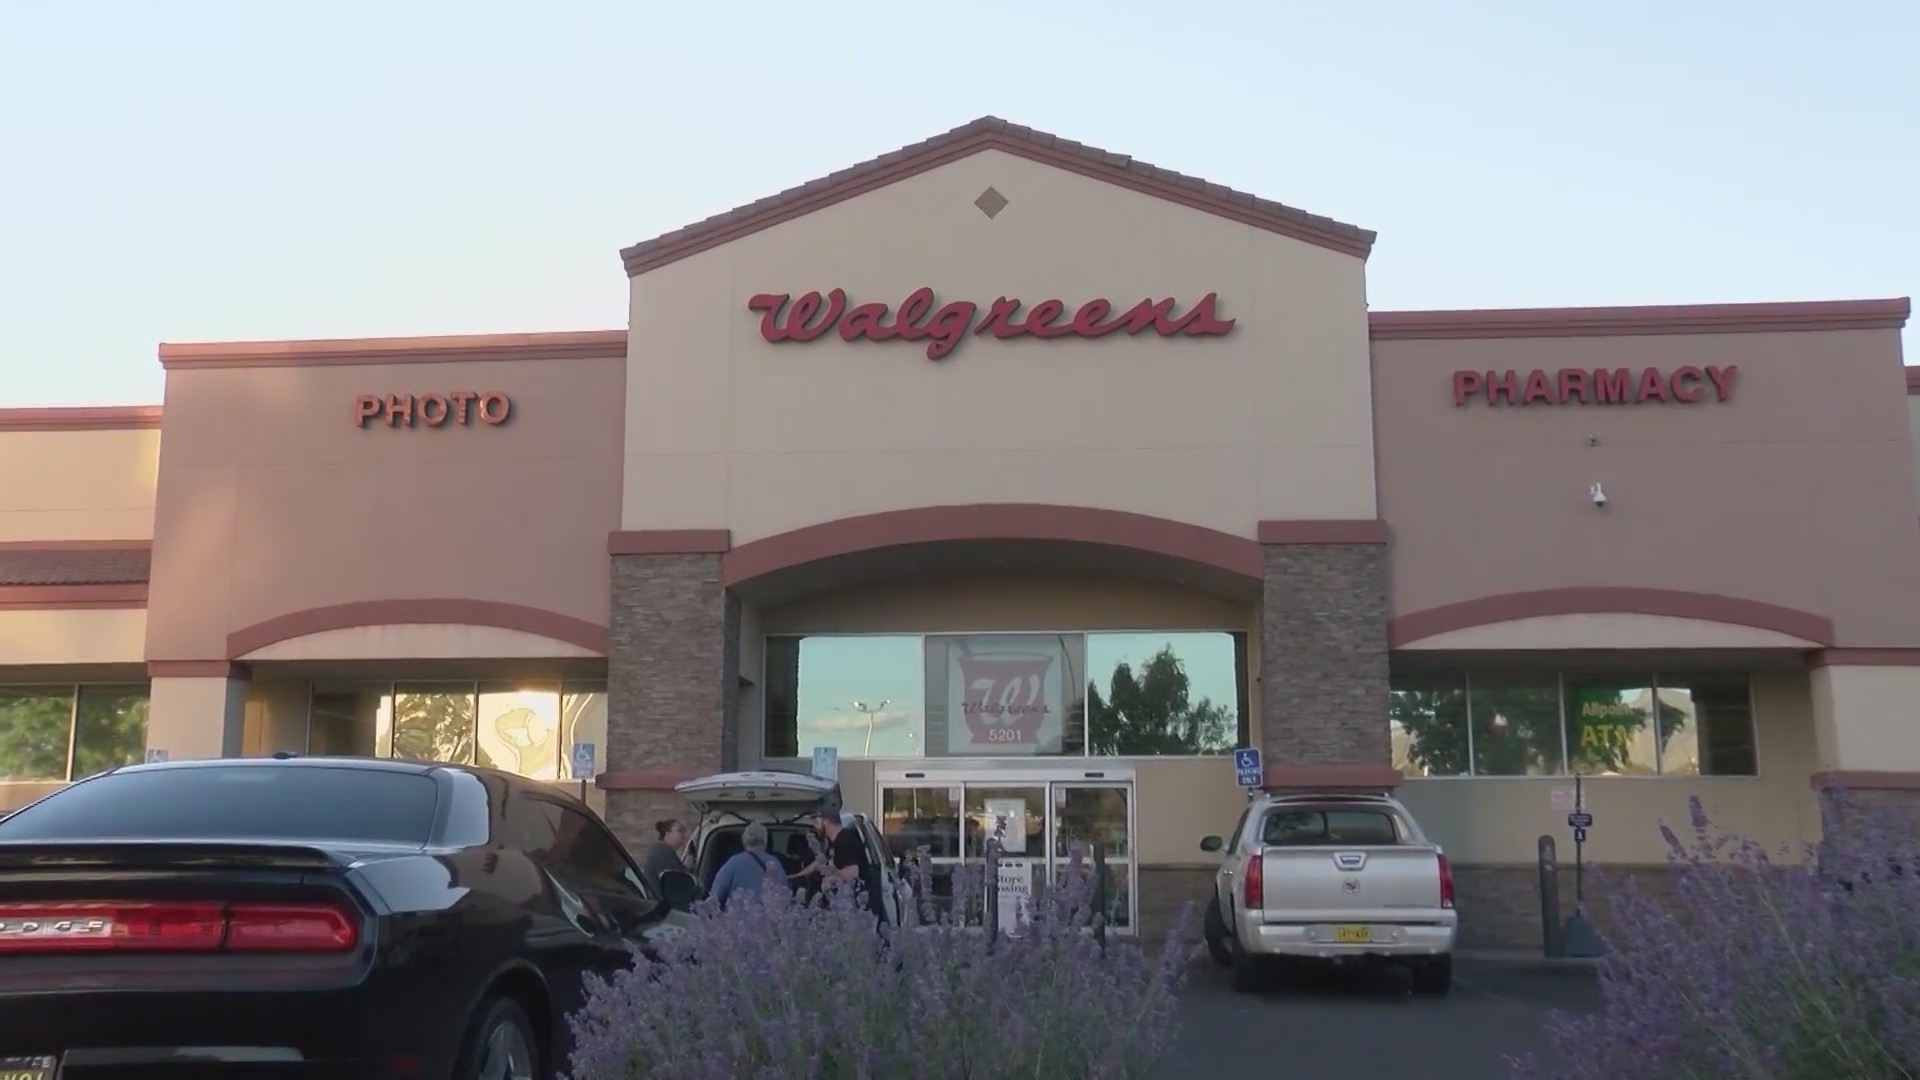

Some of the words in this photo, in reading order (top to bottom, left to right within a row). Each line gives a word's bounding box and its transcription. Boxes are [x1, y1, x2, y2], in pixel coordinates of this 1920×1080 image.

[748, 286, 1237, 360] Walgreens
[1452, 365, 1738, 406] PHARMACY
[355, 390, 510, 428] PHOTO
[988, 729, 1022, 742] 5201
[998, 875, 1024, 884] tore
